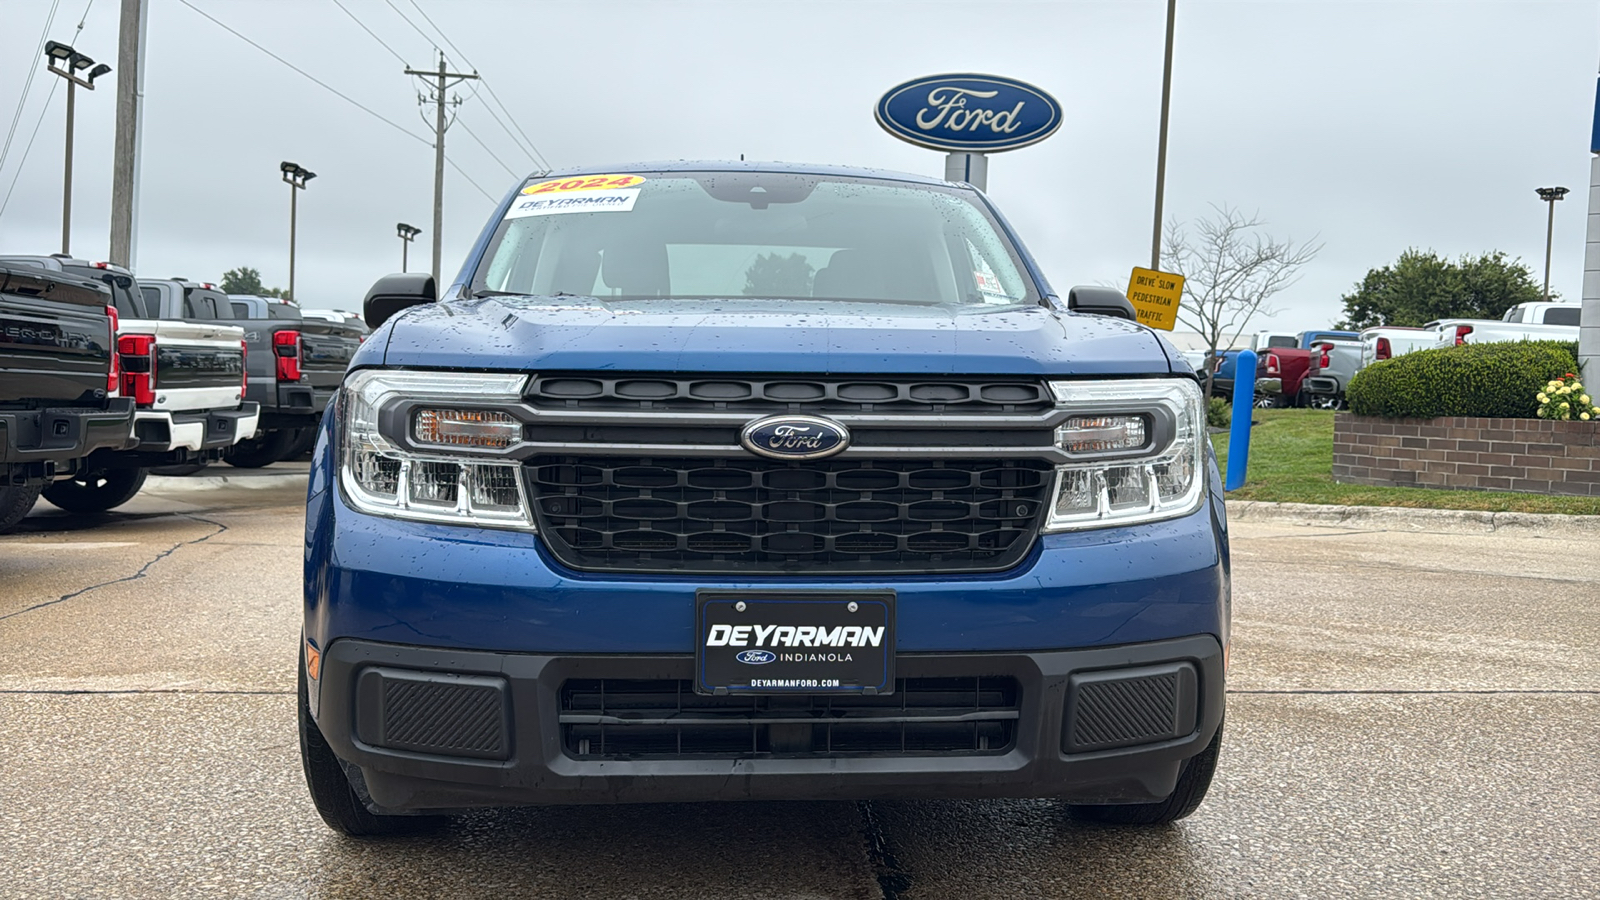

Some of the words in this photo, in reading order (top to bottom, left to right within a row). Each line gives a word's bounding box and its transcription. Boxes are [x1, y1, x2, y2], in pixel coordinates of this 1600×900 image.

[916, 87, 1026, 133] Ford
[530, 175, 635, 195] 2024
[518, 196, 631, 210] DEYARMAN
[1136, 275, 1156, 288] DRIVE
[1158, 279, 1176, 291] SLOW
[1132, 291, 1172, 307] PEDESTRIAN
[1136, 308, 1163, 322] TRAFFIC
[769, 425, 824, 448] Ford
[706, 624, 886, 648] DEYARMAN
[743, 651, 769, 662] Ford
[780, 652, 854, 662] INDIANOLA
[750, 678, 840, 688] DEYARMANFORD.COM
